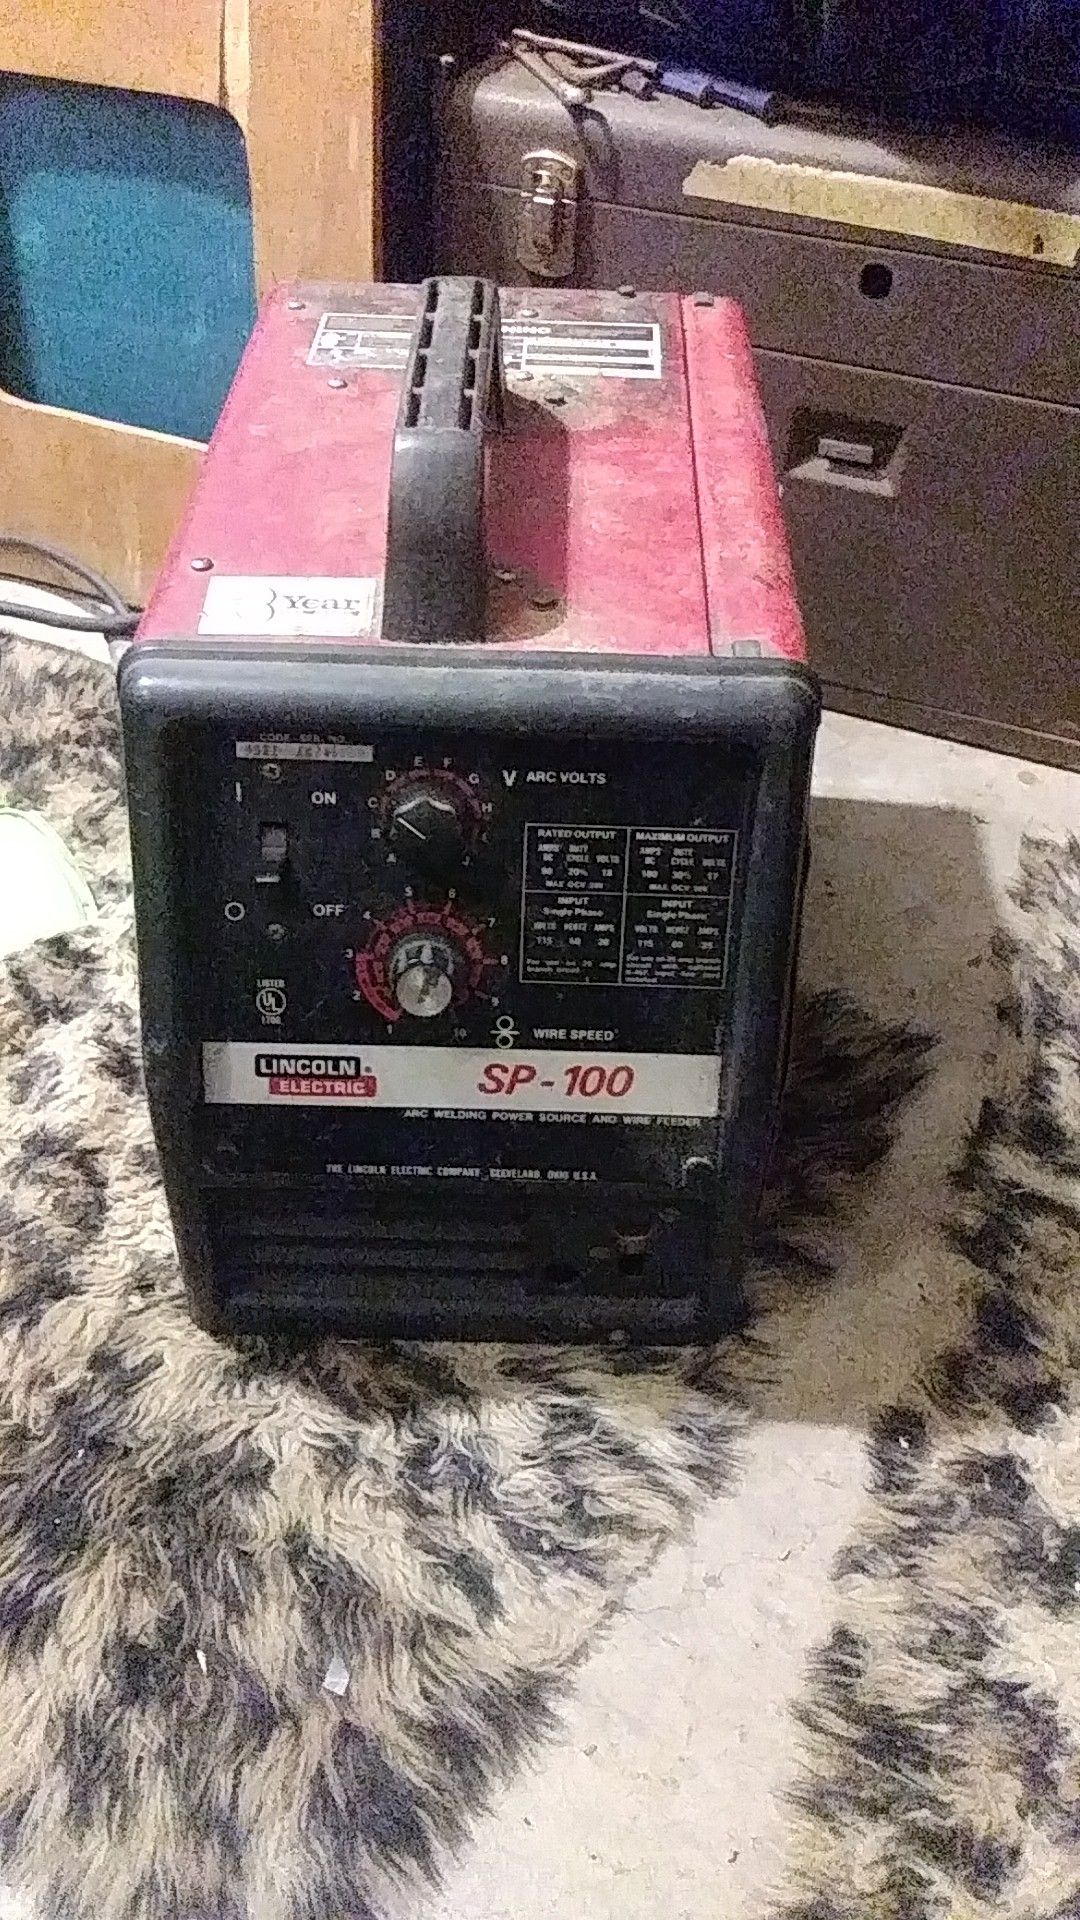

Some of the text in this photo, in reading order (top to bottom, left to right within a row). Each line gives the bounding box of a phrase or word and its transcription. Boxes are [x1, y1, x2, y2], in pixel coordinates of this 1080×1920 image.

[414, 756, 424, 767] E
[385, 769, 396, 781] D
[468, 772, 480, 784] G
[502, 769, 607, 787] V ARC VOLTS
[311, 791, 337, 805] ON
[367, 796, 379, 809] C
[481, 802, 493, 813] H
[538, 829, 617, 839] RATED OUTPUT
[636, 832, 730, 844] MAXIMUM OUTPUT
[312, 903, 345, 918] OFF
[532, 1028, 615, 1042] WIRE SPEED
[260, 1058, 357, 1076] LINCOLN
[279, 1079, 366, 1095] ELECTRIC
[402, 1109, 701, 1128] ARC WELDING POWER SOURCE AND WIRE FEEDER
